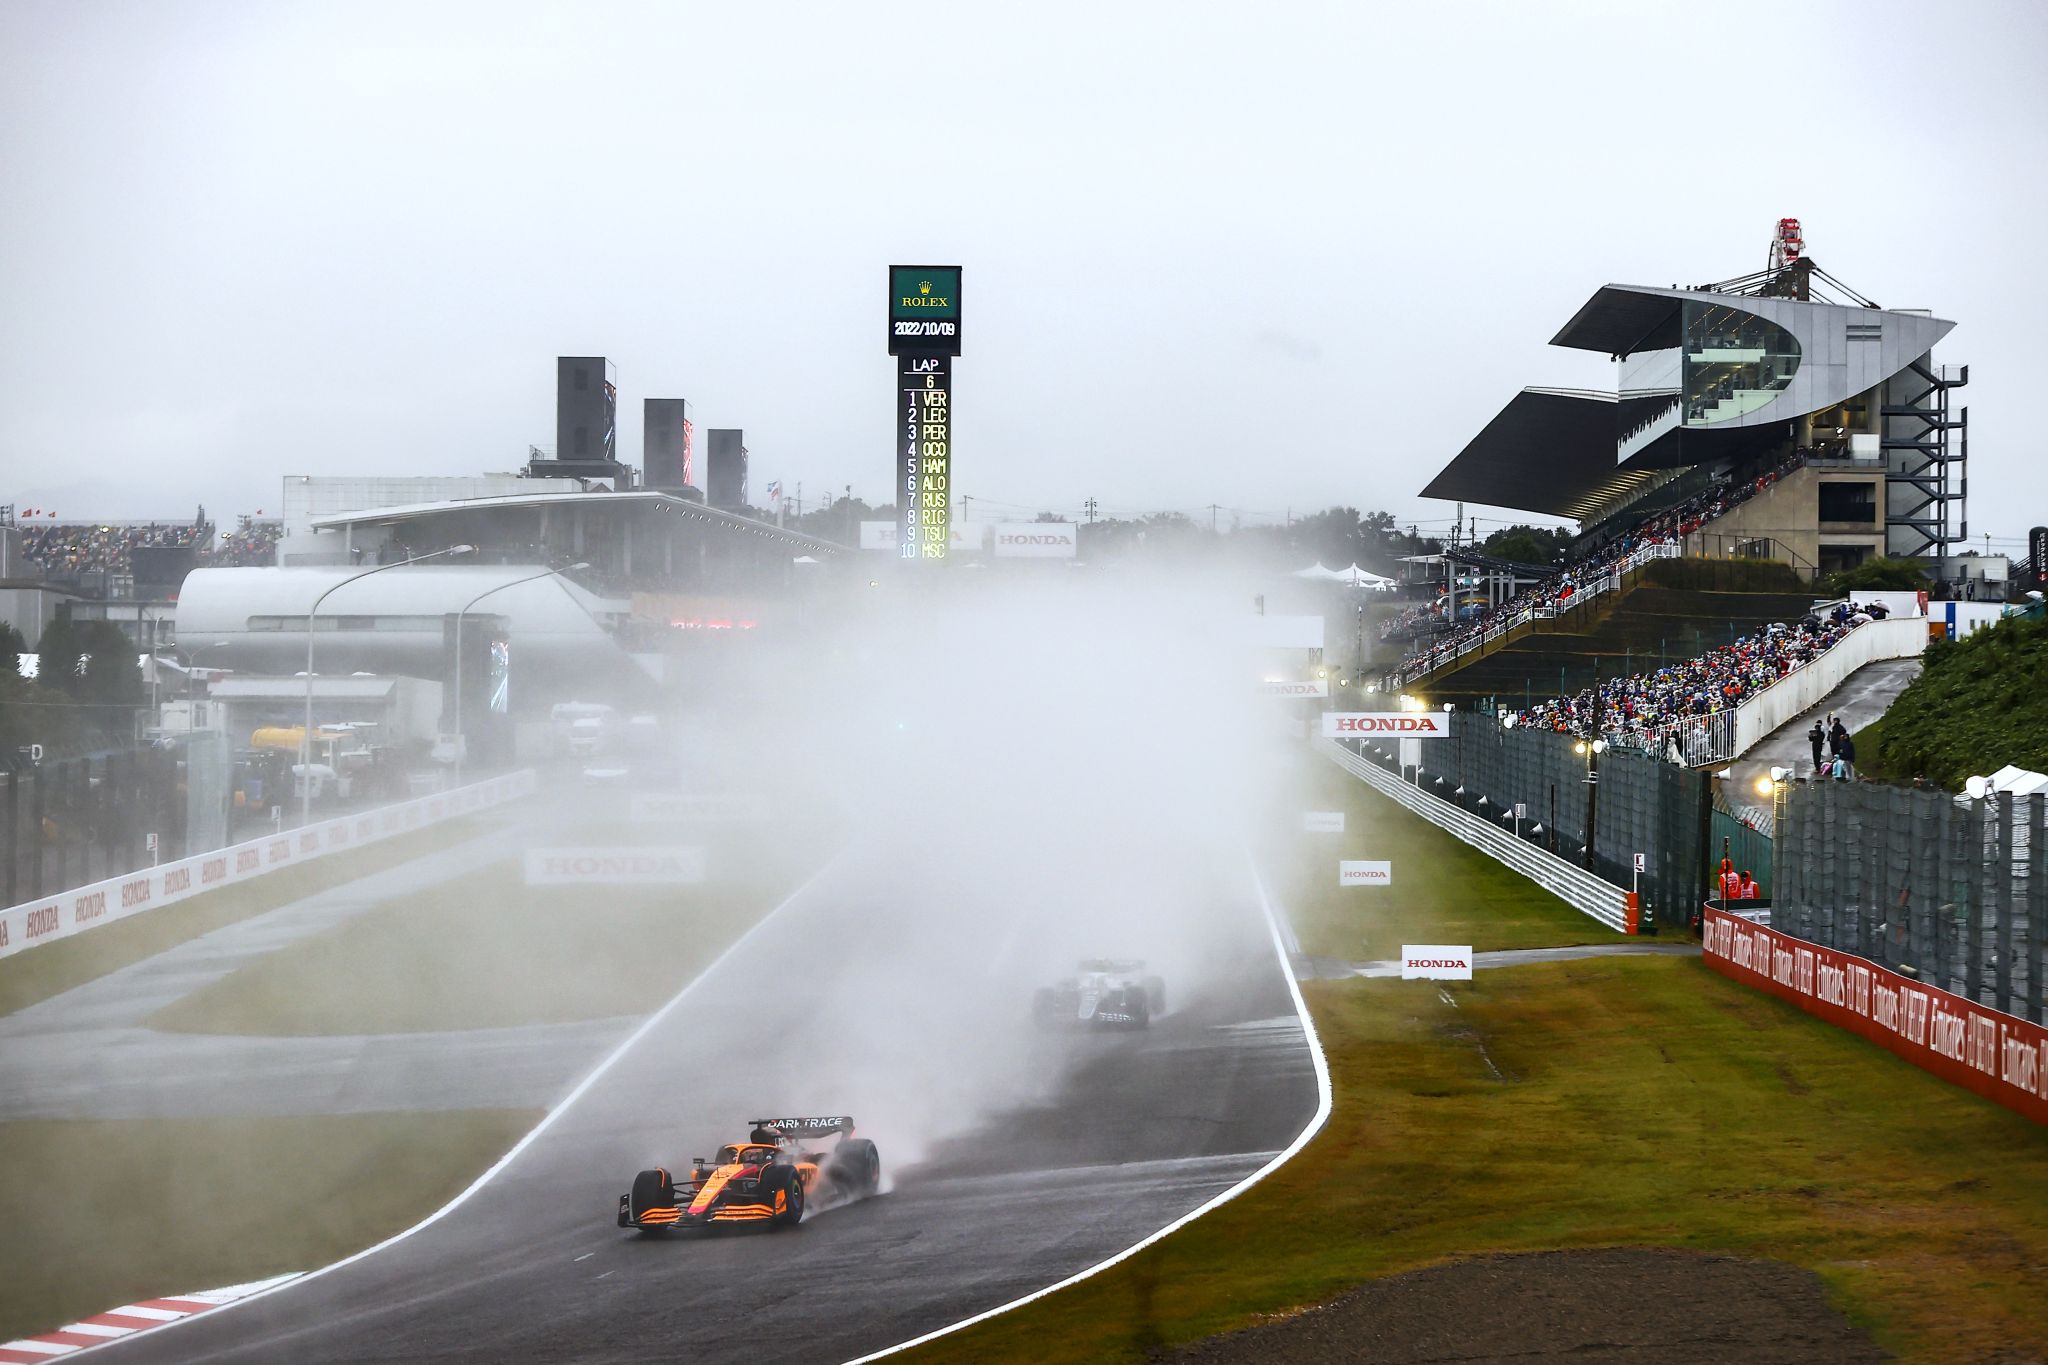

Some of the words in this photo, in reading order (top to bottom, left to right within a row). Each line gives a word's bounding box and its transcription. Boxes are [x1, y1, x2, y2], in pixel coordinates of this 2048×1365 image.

[902, 297, 948, 307] ROLEX
[894, 321, 955, 336] 2022/10/09
[912, 358, 939, 372] LAP
[926, 375, 934, 389] 6
[909, 392, 916, 406] 1
[923, 392, 947, 406] VER
[908, 408, 917, 423] 2
[923, 408, 947, 423] LEC
[908, 424, 917, 440] 3
[923, 424, 946, 440] PER
[908, 442, 916, 456] 4
[923, 442, 946, 456] OCO
[908, 458, 916, 474] 5
[923, 458, 946, 474] HAM
[908, 476, 916, 490] 6
[922, 476, 946, 490] ALO
[908, 493, 916, 508] 7
[922, 493, 946, 508] RUS
[908, 510, 916, 524] 8
[922, 510, 946, 524] RIC
[908, 526, 916, 541] 9
[922, 526, 945, 541] TSU
[1000, 535, 1071, 545] HONDA
[901, 544, 915, 558] 10
[922, 544, 945, 558] MSC
[1335, 718, 1438, 731] HONDA
[32, 744, 43, 760] D
[164, 868, 191, 895] HONDA
[122, 878, 151, 907] HONDA
[75, 891, 107, 922] HONDA
[26, 905, 59, 939] HONDA
[1407, 959, 1467, 968] HONDA
[1817, 953, 1845, 1007] Emirates
[1872, 973, 1898, 1033] Emirates
[1930, 998, 1966, 1062] Emirates
[2001, 1024, 2037, 1095] Emirates
